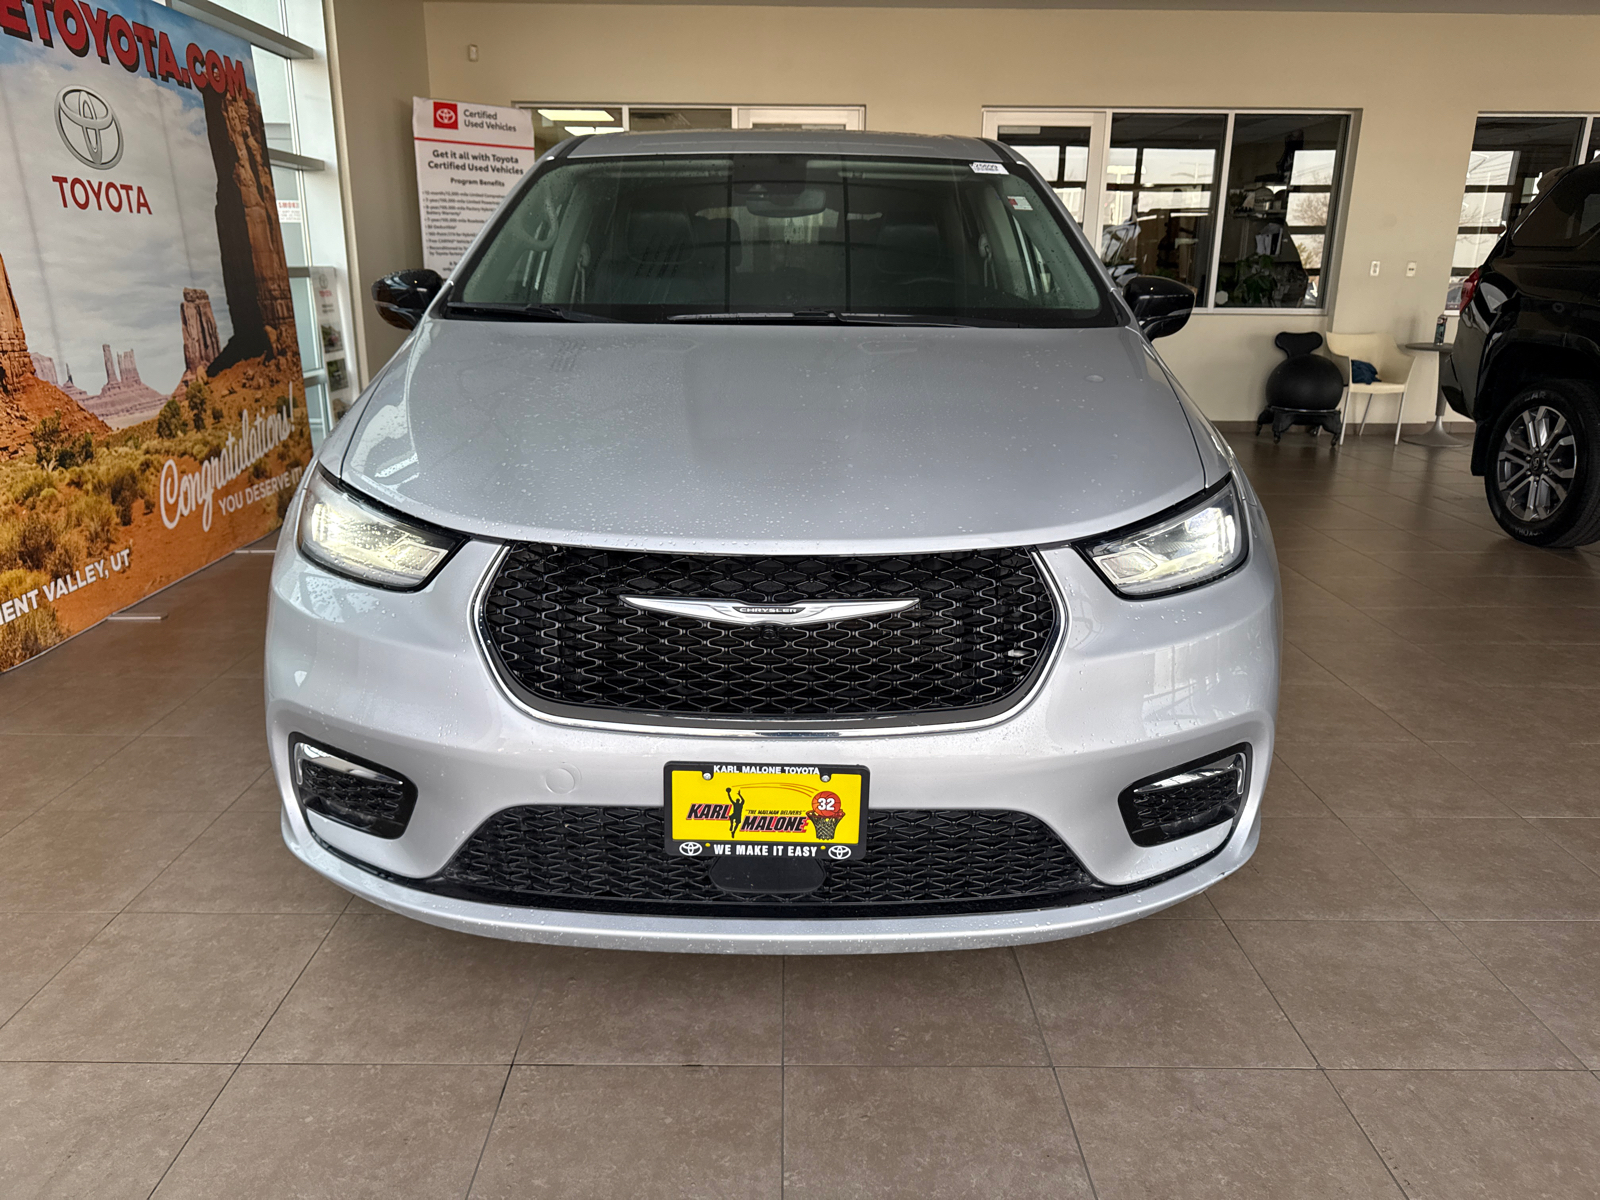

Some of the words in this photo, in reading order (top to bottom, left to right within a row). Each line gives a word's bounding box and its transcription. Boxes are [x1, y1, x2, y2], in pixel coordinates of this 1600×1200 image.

[463, 109, 498, 120] Certified
[464, 120, 484, 129] Used
[485, 121, 517, 132] Vehicles
[432, 149, 449, 159] Get
[450, 150, 457, 160] it
[458, 151, 470, 160] all
[471, 152, 490, 162] with
[491, 154, 519, 165] Toyota
[428, 160, 466, 171] Certified
[468, 162, 489, 172] Used
[490, 164, 524, 175] Vehicles
[450, 177, 478, 187] Program
[479, 178, 505, 188] Benefits
[52, 175, 153, 215] TOYOTA
[159, 381, 295, 533] Congratulations!
[218, 491, 244, 516] YOU
[245, 471, 291, 505] DESERVE
[42, 559, 110, 603] VALLEY,
[110, 548, 130, 572] UT
[713, 765, 740, 774] KARL
[742, 766, 782, 775] MALONE
[784, 766, 820, 775] TOYOTA
[817, 797, 835, 811] 32
[686, 803, 733, 821] KARL
[740, 815, 807, 833] MALONE
[713, 844, 732, 855] WE
[735, 844, 769, 856] MAKE
[773, 845, 783, 856] IT
[787, 846, 818, 857] EASY
